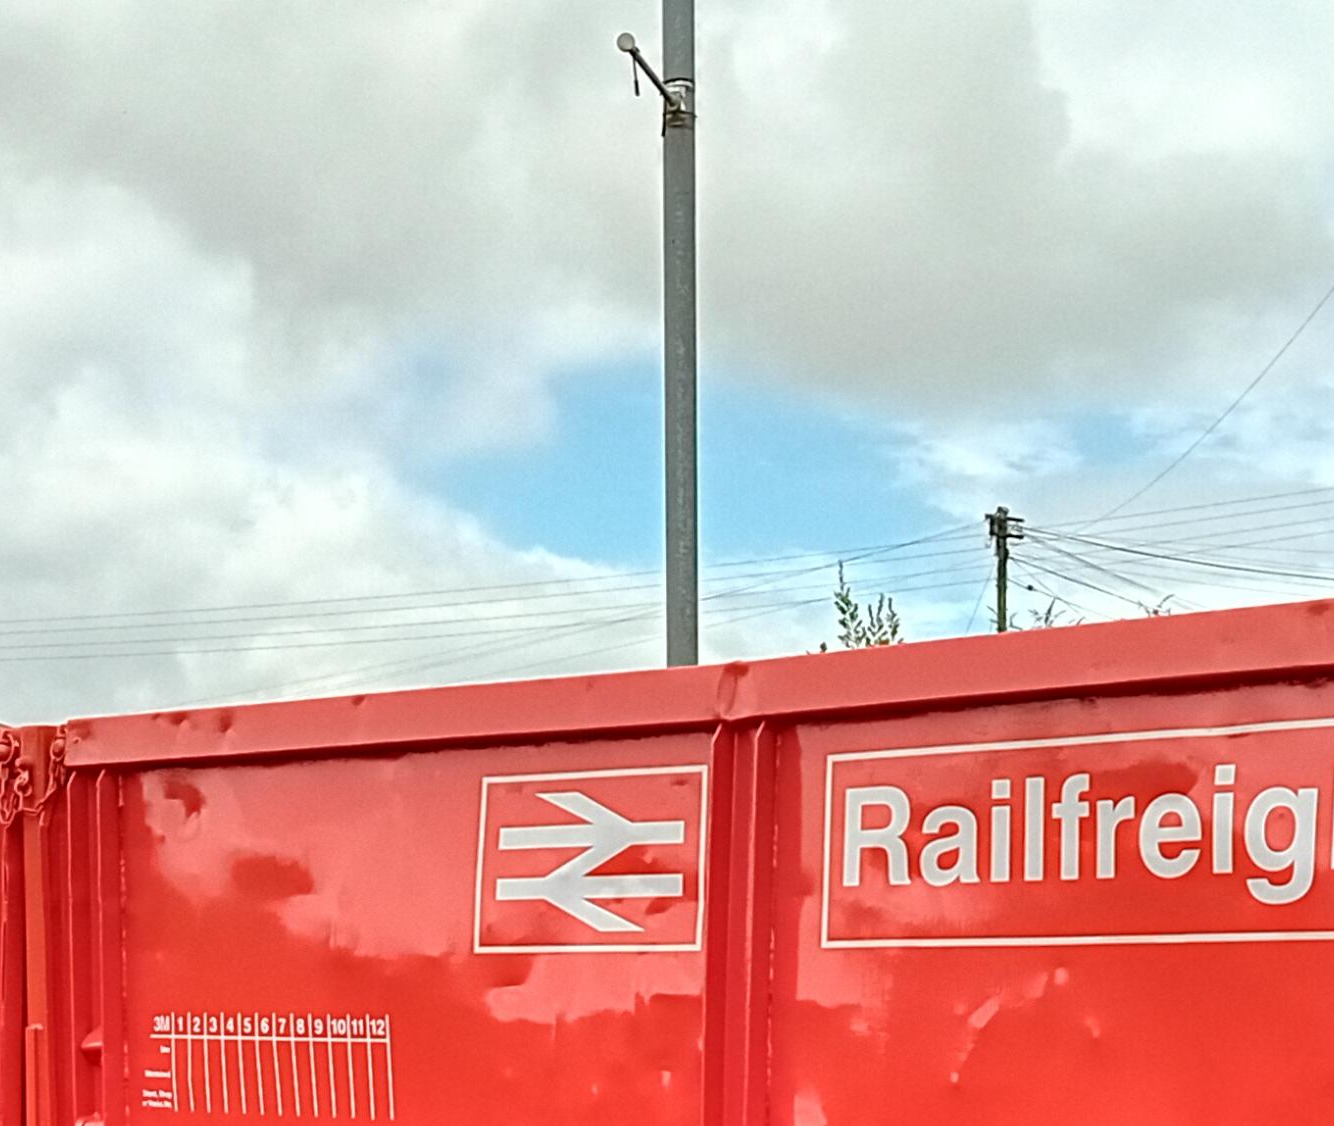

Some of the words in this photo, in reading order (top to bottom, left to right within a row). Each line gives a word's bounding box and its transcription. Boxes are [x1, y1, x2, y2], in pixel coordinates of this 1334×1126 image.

[153, 1015, 171, 1033] 3M
[176, 1016, 184, 1032] 1
[192, 1016, 201, 1032] 2
[208, 1016, 218, 1033] 3
[226, 1016, 235, 1033] 4
[243, 1016, 252, 1033] 5
[260, 1017, 269, 1034] 6
[278, 1017, 287, 1034] 7
[295, 1017, 305, 1035] 8
[313, 1018, 323, 1035] 9
[330, 1018, 347, 1035] 10
[351, 1018, 365, 1036] 11
[369, 1018, 386, 1036] 12
